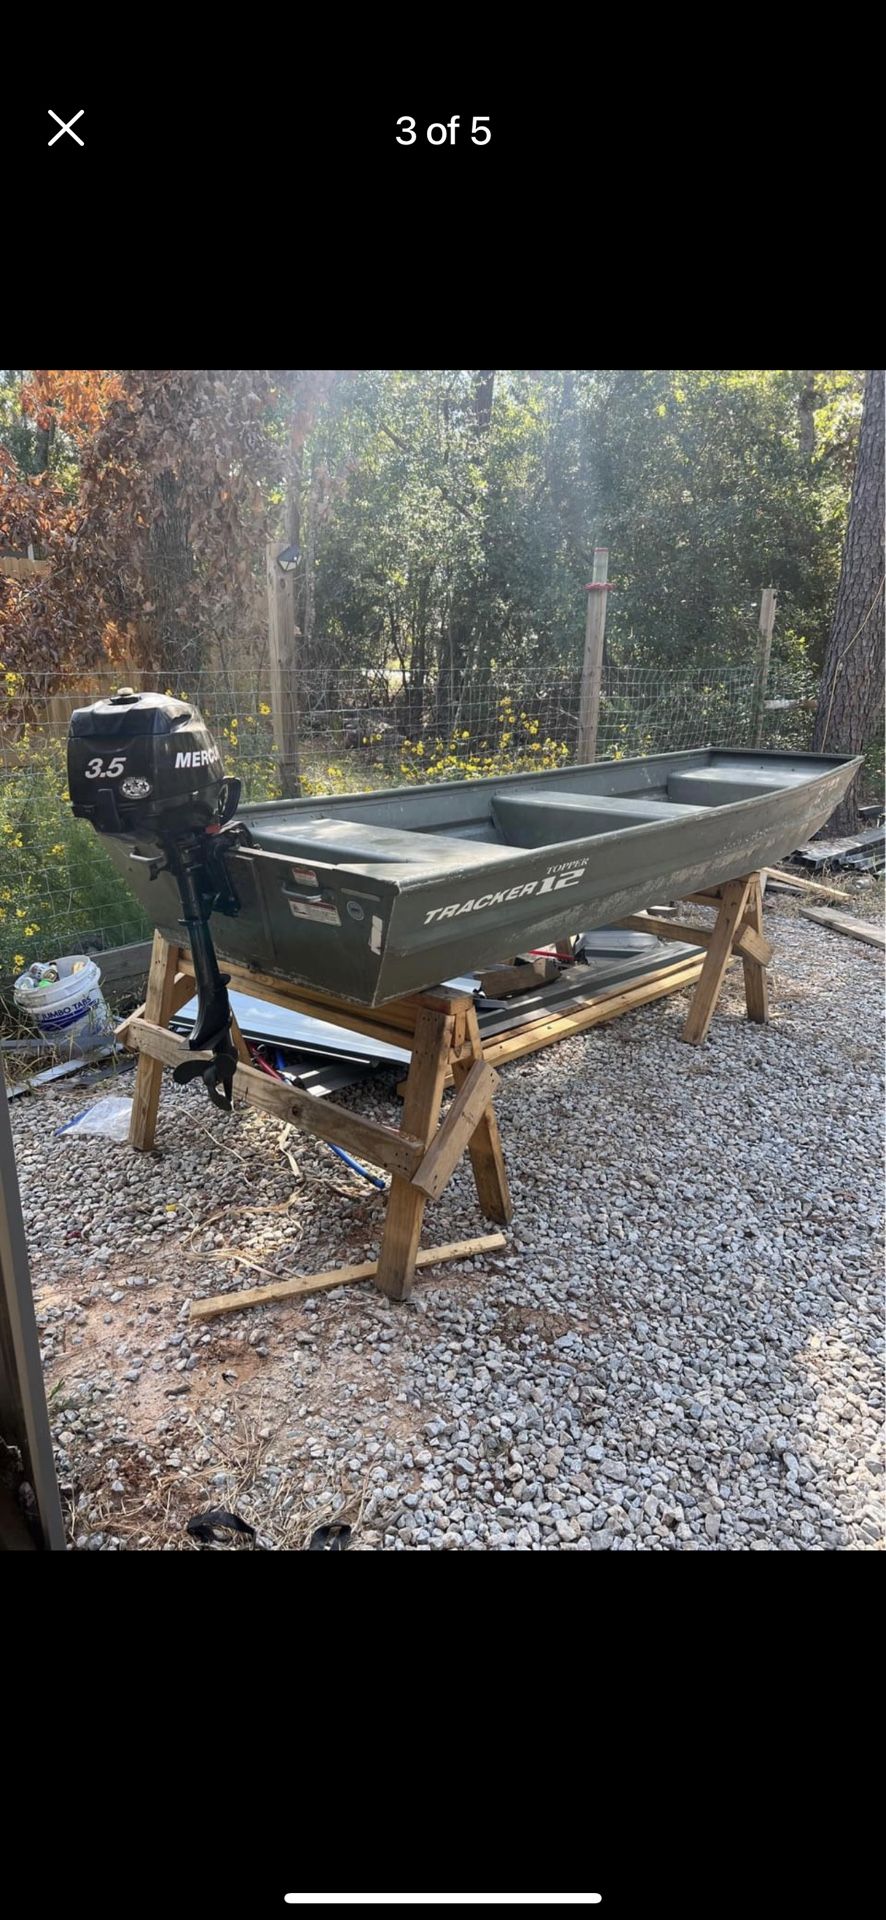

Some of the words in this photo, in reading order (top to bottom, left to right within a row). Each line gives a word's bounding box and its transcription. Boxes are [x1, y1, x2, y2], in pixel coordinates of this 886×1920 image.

[85, 757, 126, 779] 3.5
[546, 857, 590, 875] TOPPER
[423, 881, 538, 925] TRACKER
[535, 868, 586, 896] 12
